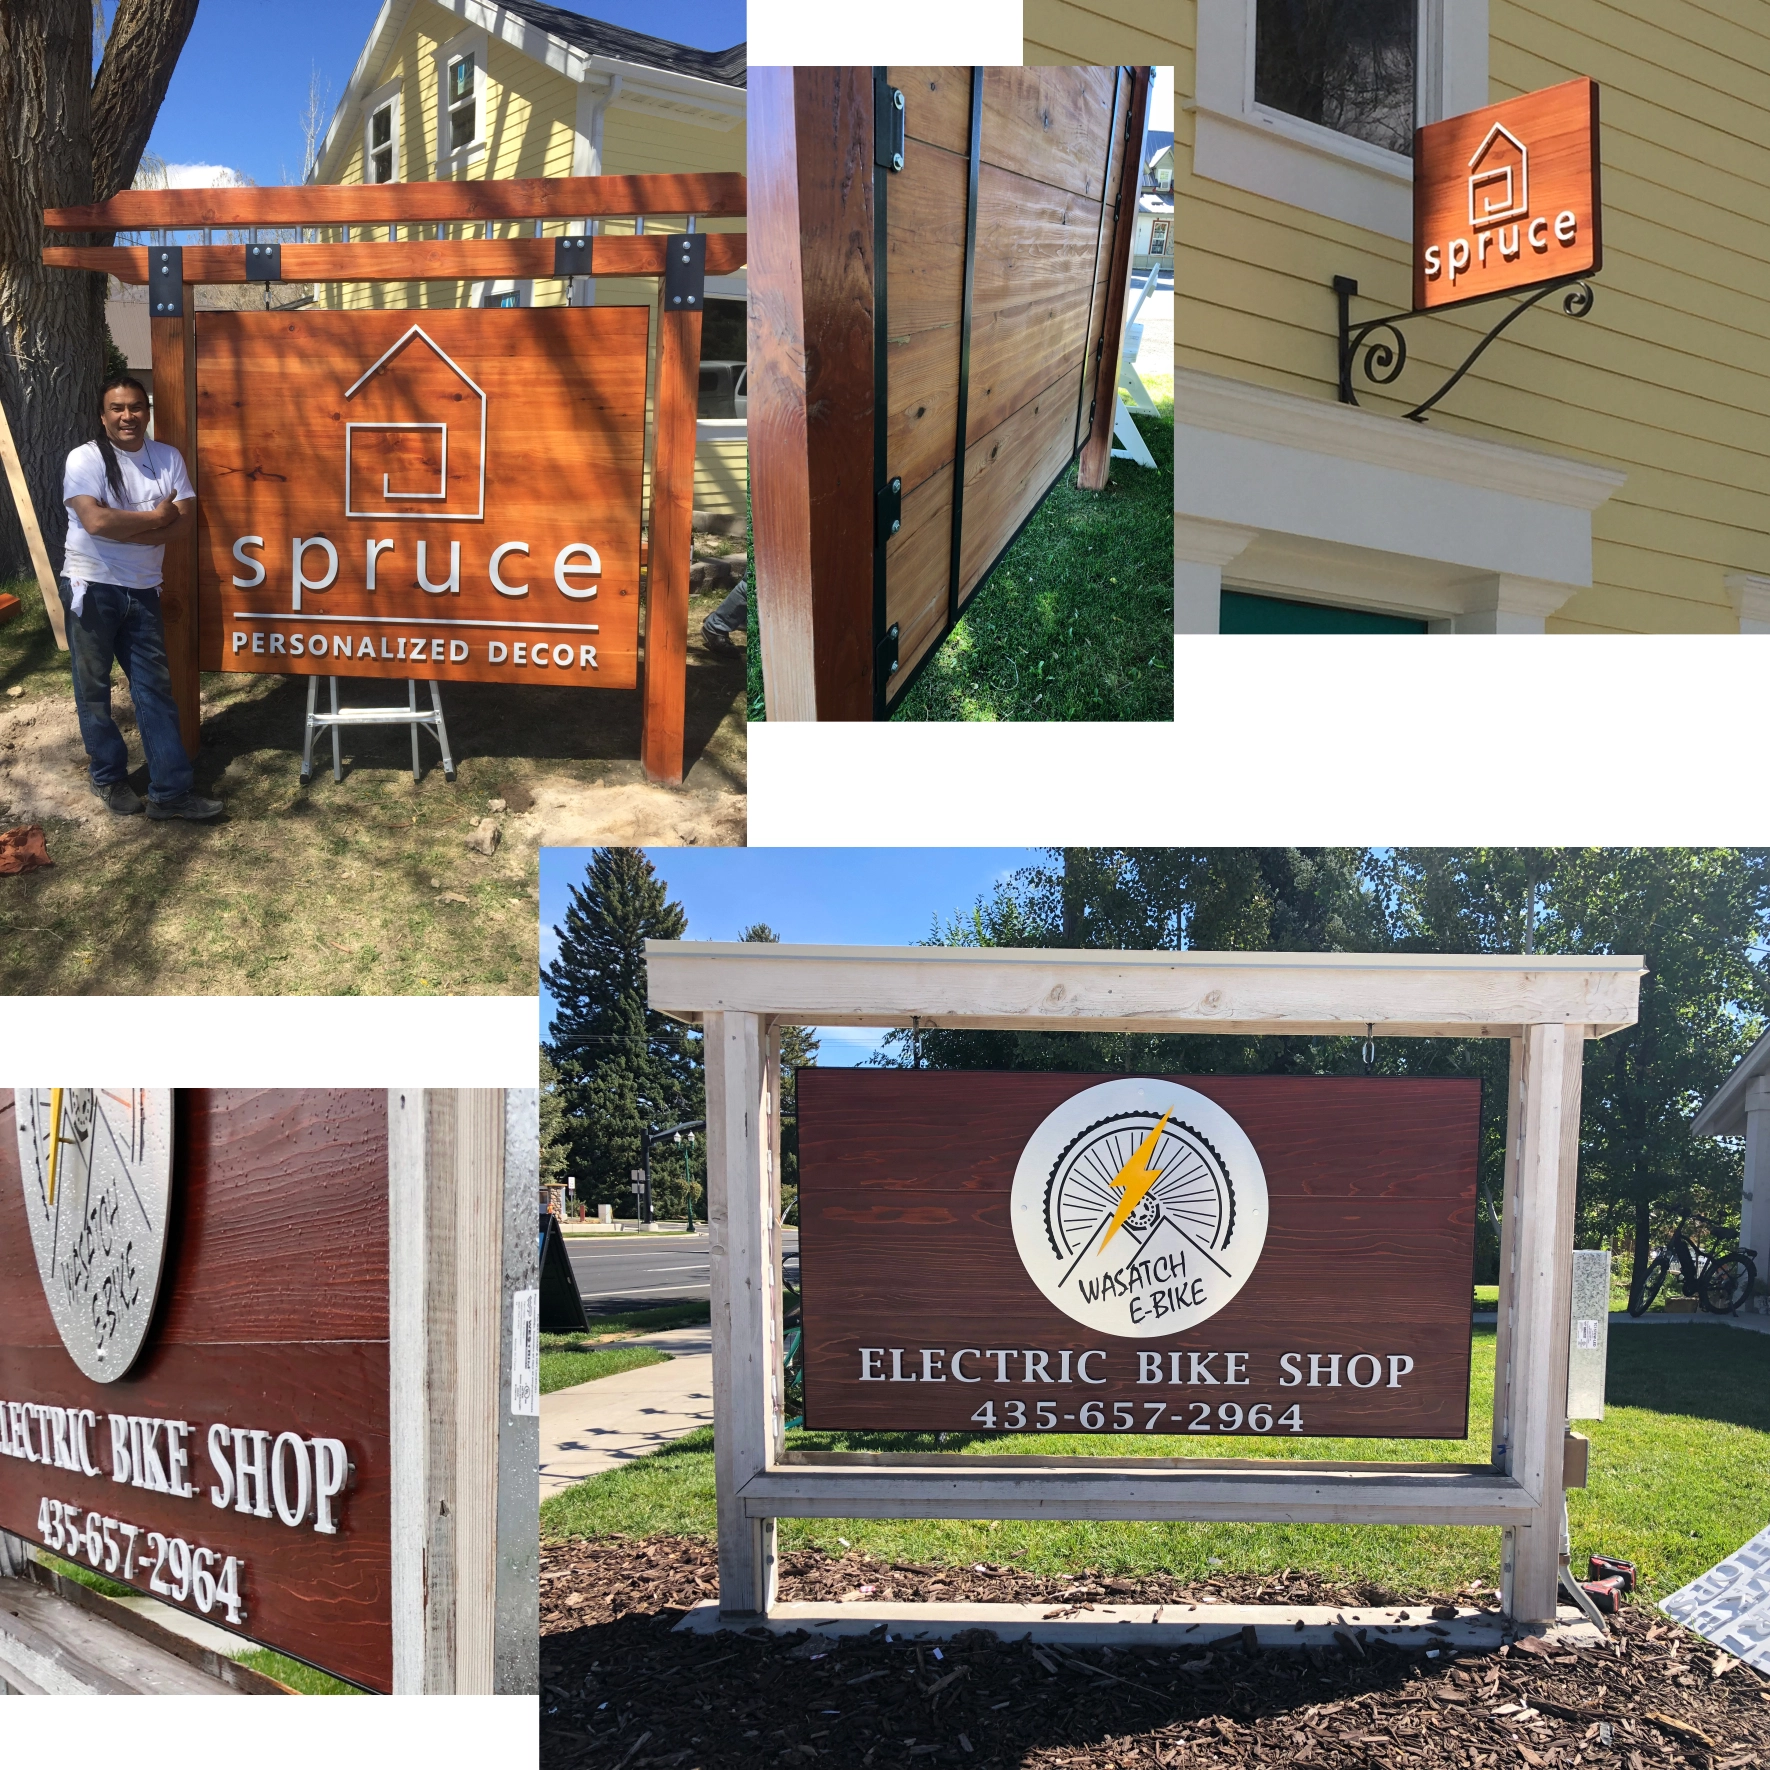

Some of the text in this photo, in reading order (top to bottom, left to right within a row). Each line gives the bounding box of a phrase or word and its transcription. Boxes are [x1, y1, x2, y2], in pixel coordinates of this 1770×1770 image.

[1425, 210, 1576, 280] spruce
[232, 535, 601, 611] spruce
[232, 631, 599, 668] PERSONALIZED DECOR
[1078, 1250, 1186, 1304] WASATCH
[1129, 1278, 1207, 1324] E-BIKE
[858, 1347, 1415, 1388] ELECTRIC BIKE SHOP
[970, 1400, 1304, 1432] 435-657-2964
[0, 1401, 349, 1535] LECTRIC BIKE SHOP
[37, 1497, 242, 1625] 435-657-2964
